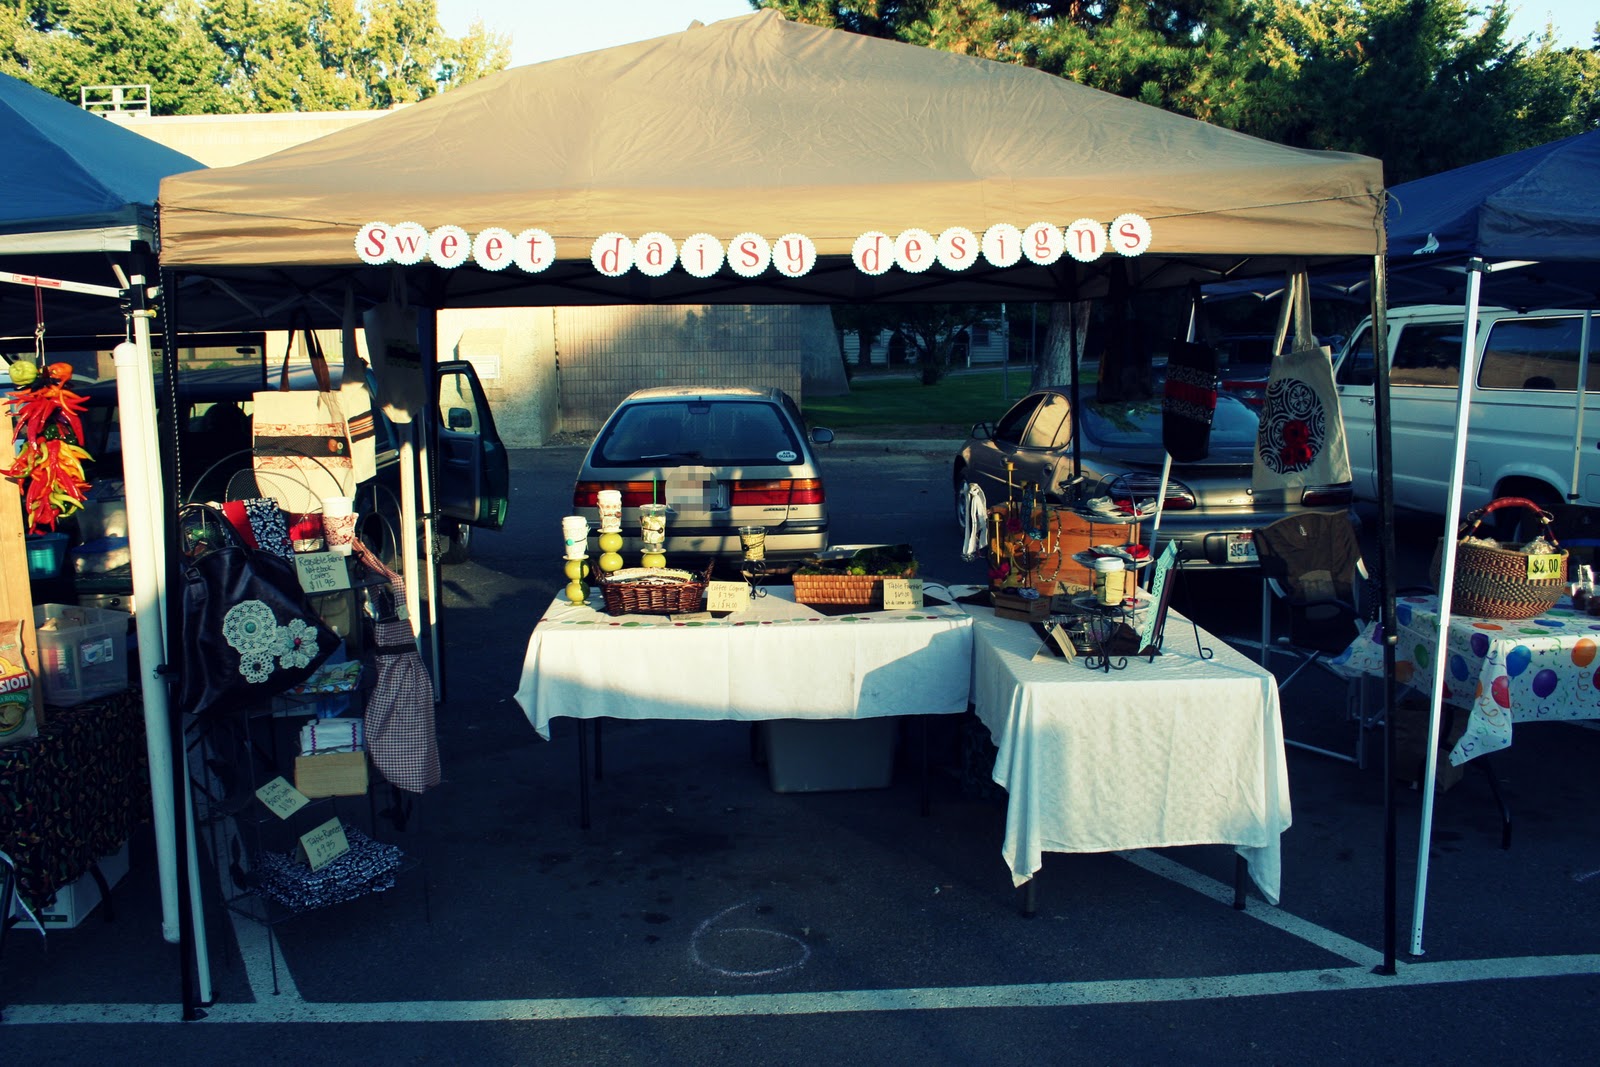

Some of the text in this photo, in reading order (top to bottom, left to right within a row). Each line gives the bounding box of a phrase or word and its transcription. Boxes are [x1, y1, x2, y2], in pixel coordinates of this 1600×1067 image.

[364, 222, 1142, 274] Sweet daisy designs
[305, 564, 335, 574] Notebook
[1532, 558, 1559, 574] $2.00
[311, 572, 331, 580] Covers
[310, 578, 335, 591] $11.95
[306, 835, 325, 847] Table
